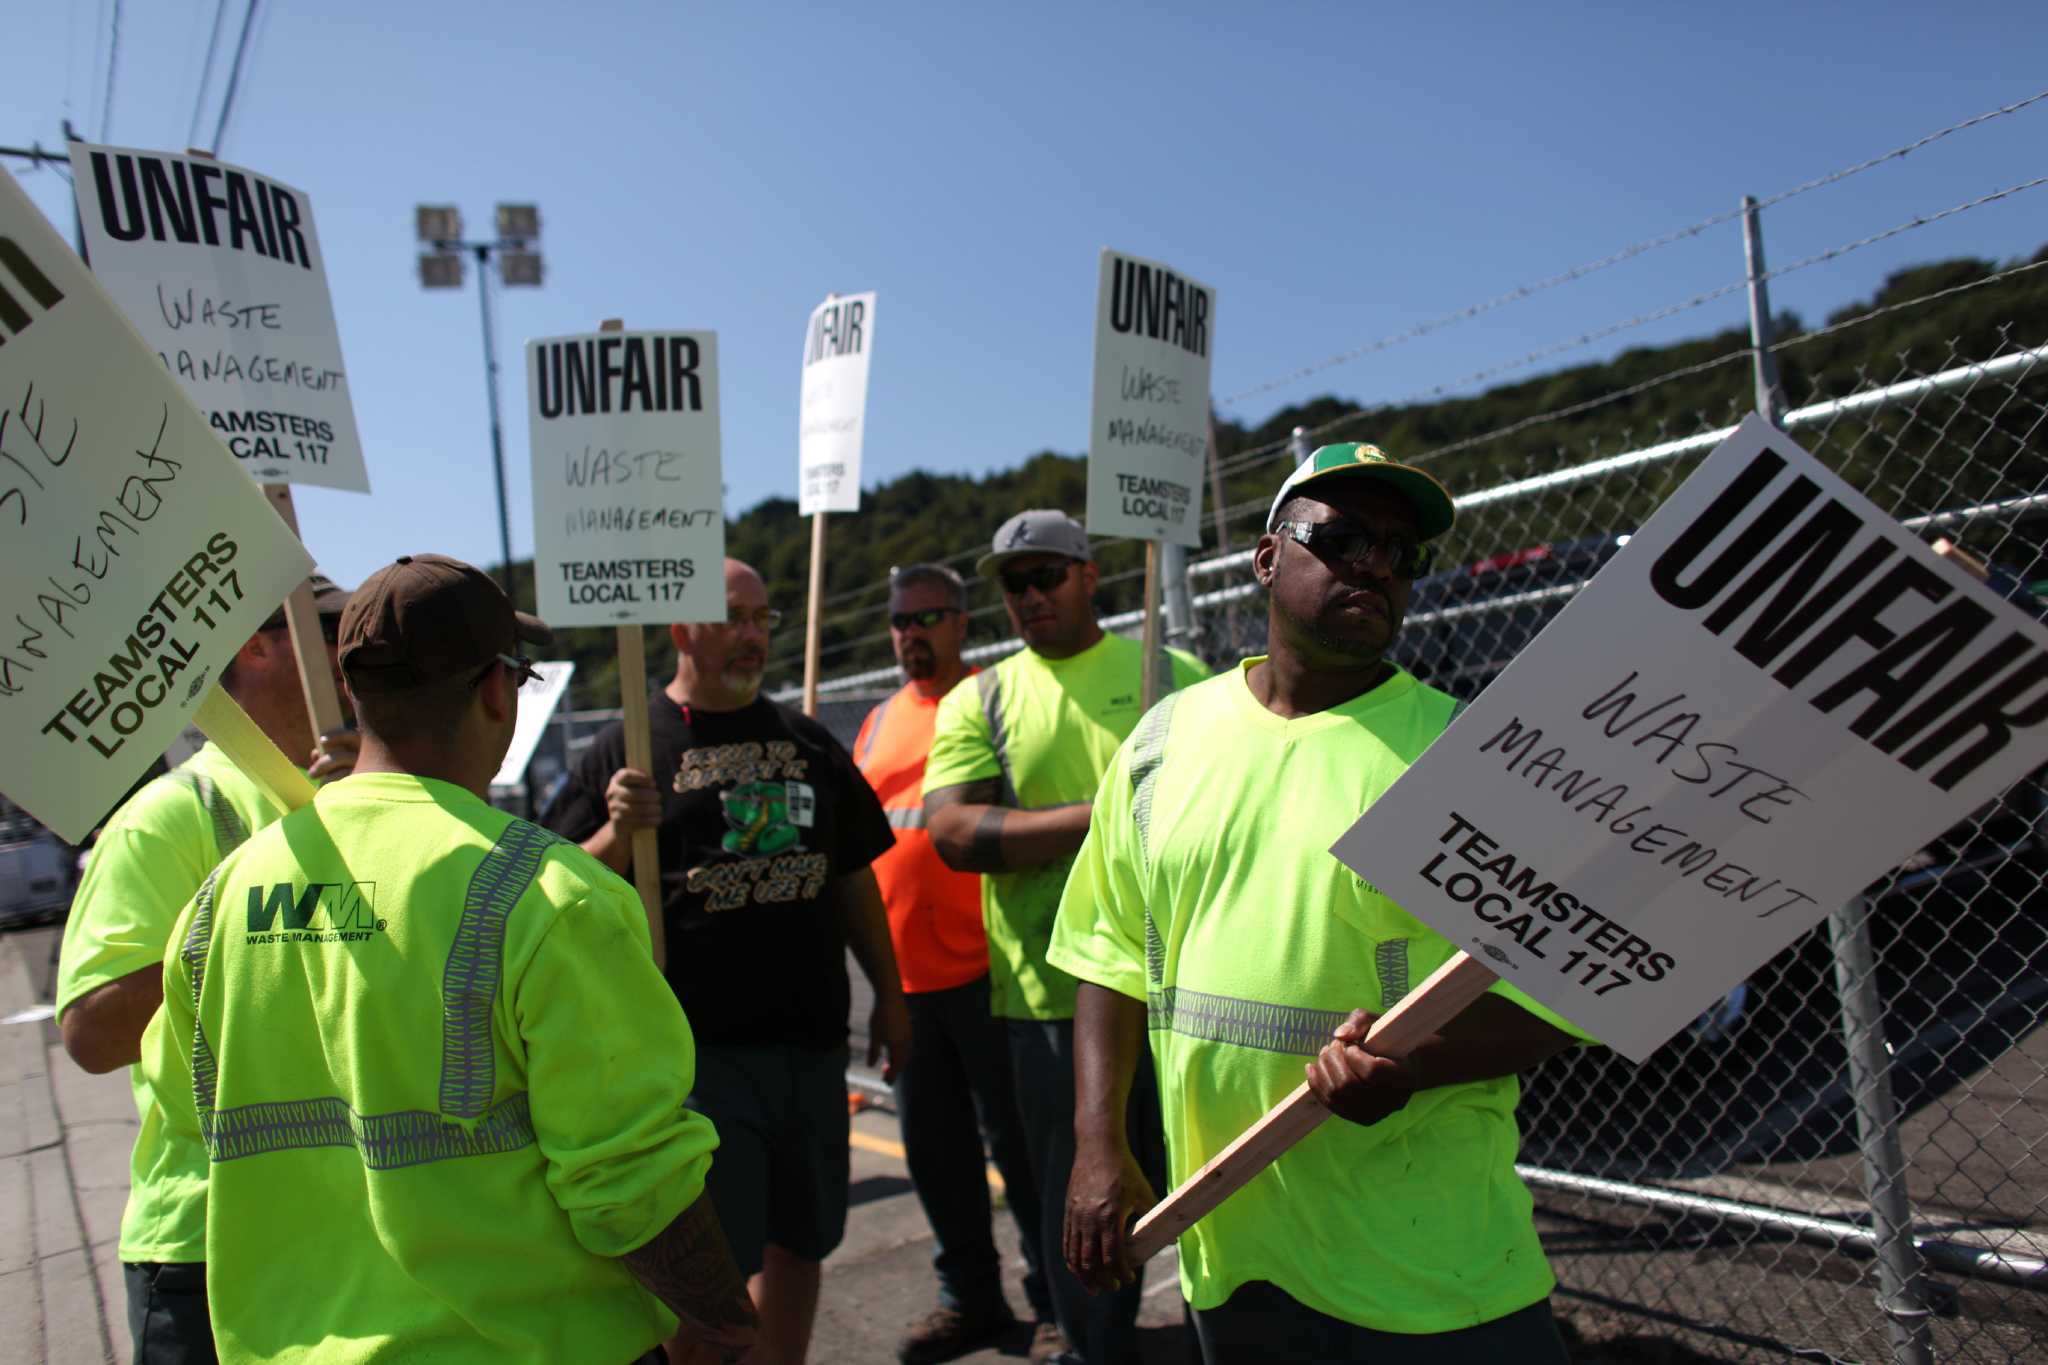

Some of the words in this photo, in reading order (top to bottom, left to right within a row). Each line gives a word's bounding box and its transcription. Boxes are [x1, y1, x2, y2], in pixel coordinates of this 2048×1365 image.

[90, 152, 312, 271] UNFAIR
[157, 284, 282, 330] WASTE
[1110, 257, 1209, 358] UNFAIR
[159, 349, 344, 392] ANAGEMENT
[537, 336, 702, 420] UNFAIR
[1120, 364, 1182, 404] WASTE
[209, 410, 334, 443] AMSTERS
[1107, 416, 1204, 457] MANAGEMENT
[295, 441, 330, 465] 117
[565, 446, 688, 488] WASTE
[1116, 473, 1191, 506] TEAMSTERS
[1122, 496, 1169, 521] LOCAL
[564, 508, 717, 536] MANAGEMENT
[560, 559, 694, 582] TEAMSTERS
[568, 582, 640, 605] LOCAL
[648, 583, 685, 601] 117
[41, 532, 238, 744] TEAMSTERS
[1650, 447, 2048, 793] UNFAIR
[86, 637, 200, 760] LOCAL
[193, 568, 244, 631] 117
[1582, 671, 1811, 824] WASTE
[1479, 716, 1818, 918] MANAGEMENT
[1439, 811, 1676, 982] TEAMSTERS
[246, 932, 289, 945] WASTE
[292, 931, 374, 944] MANAGEMENT
[1419, 852, 1553, 960] LOCAL
[1559, 949, 1633, 997] 117
